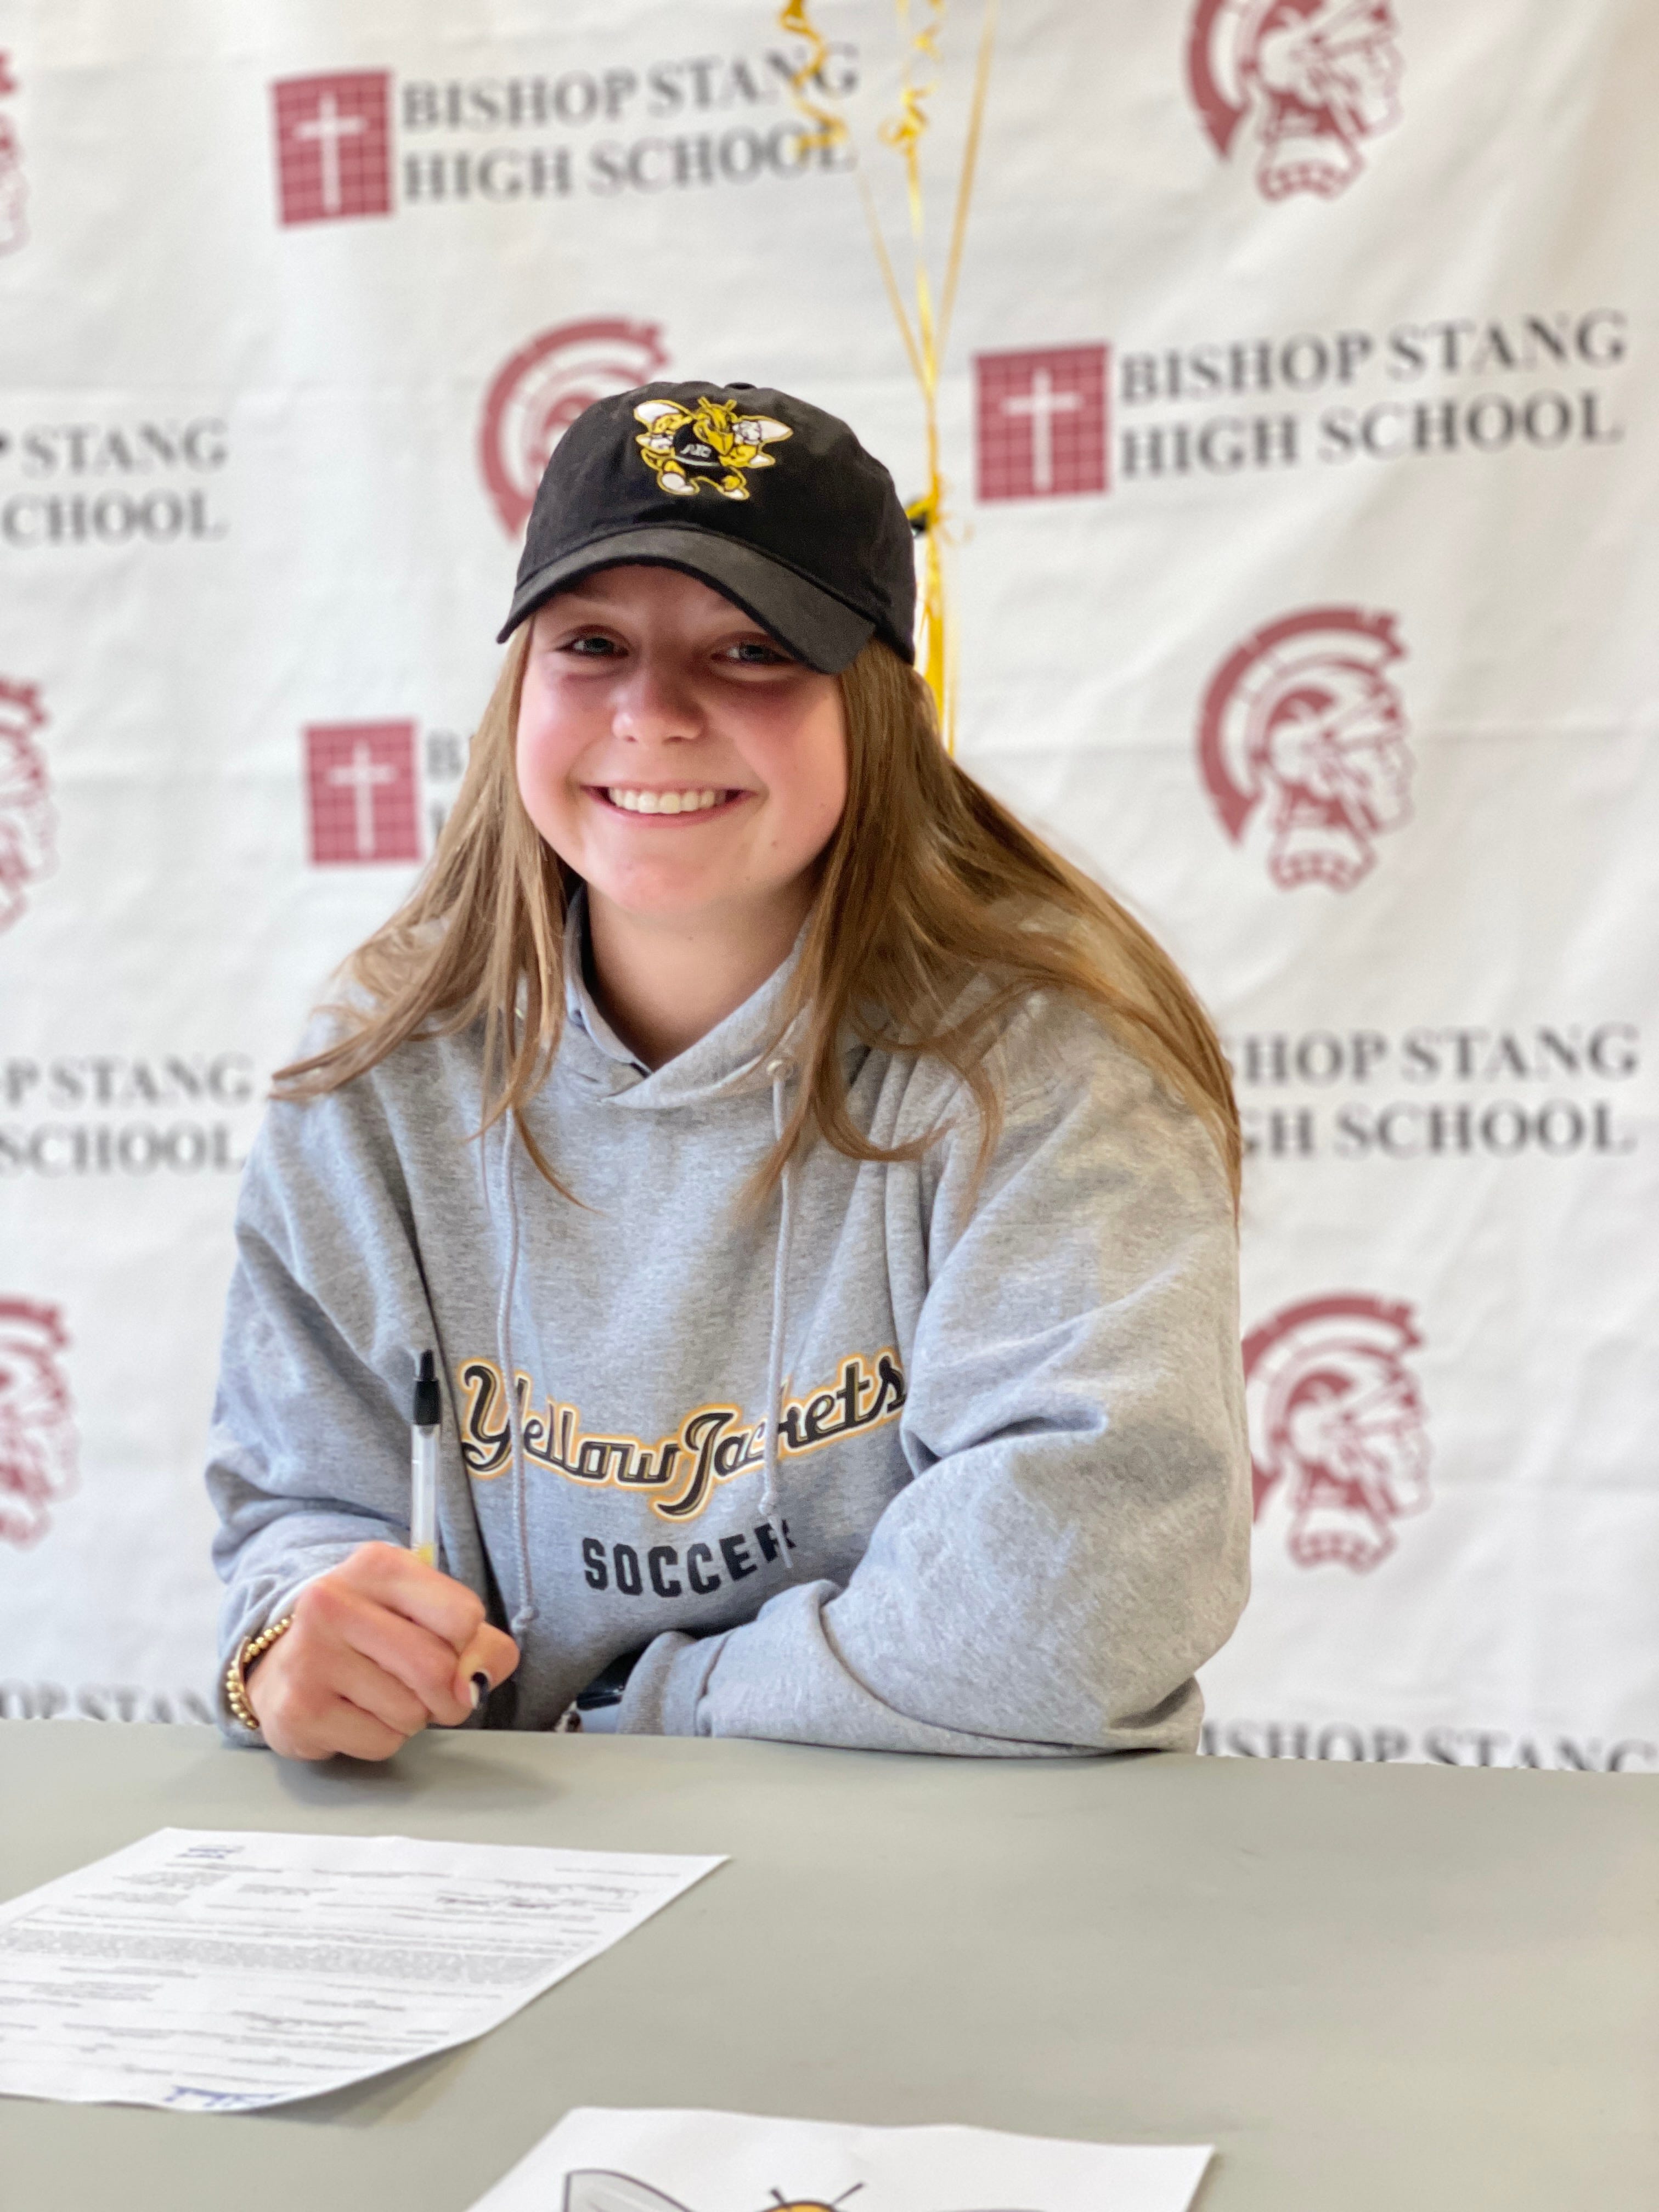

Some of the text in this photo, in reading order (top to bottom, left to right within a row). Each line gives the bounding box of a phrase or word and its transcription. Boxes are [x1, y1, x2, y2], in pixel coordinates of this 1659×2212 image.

[403, 43, 859, 133] BISHOP STANG
[404, 118, 859, 205] HIGH SCHOOL
[1120, 308, 1629, 405] BISHOP STANG
[21, 416, 229, 480] STANG
[1121, 388, 1626, 479] HIGH SCHOOL
[0, 487, 230, 550] CHOOL
[47, 1051, 255, 1111] STANG
[1222, 1022, 1640, 1088] HOP STANG
[1332, 1099, 1638, 1161] SCHOOL
[458, 1358, 683, 1487] Yellow
[582, 1520, 797, 1598] SOCCER
[1200, 1719, 1410, 1762] ISHOP
